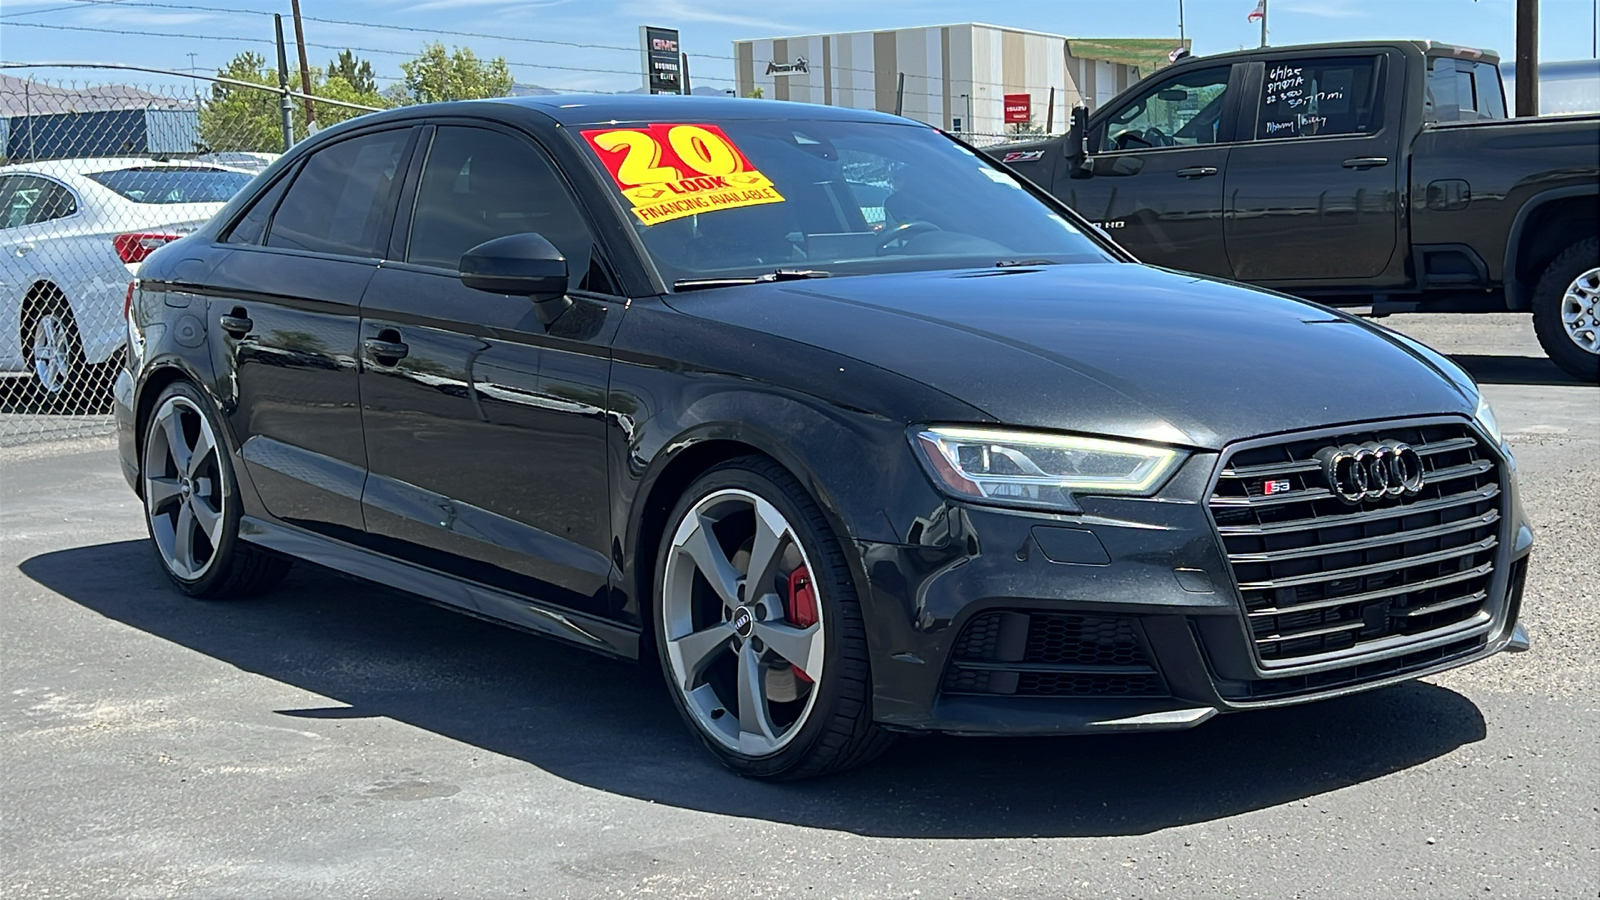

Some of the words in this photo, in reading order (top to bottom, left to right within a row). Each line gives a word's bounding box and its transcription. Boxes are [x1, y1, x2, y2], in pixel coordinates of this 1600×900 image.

[653, 38, 678, 52] GMC
[592, 125, 743, 186] 20
[665, 175, 731, 195] LOOK
[638, 196, 709, 221] FINANCING
[711, 188, 776, 207] AVAILABLE
[1271, 482, 1290, 492] S3
